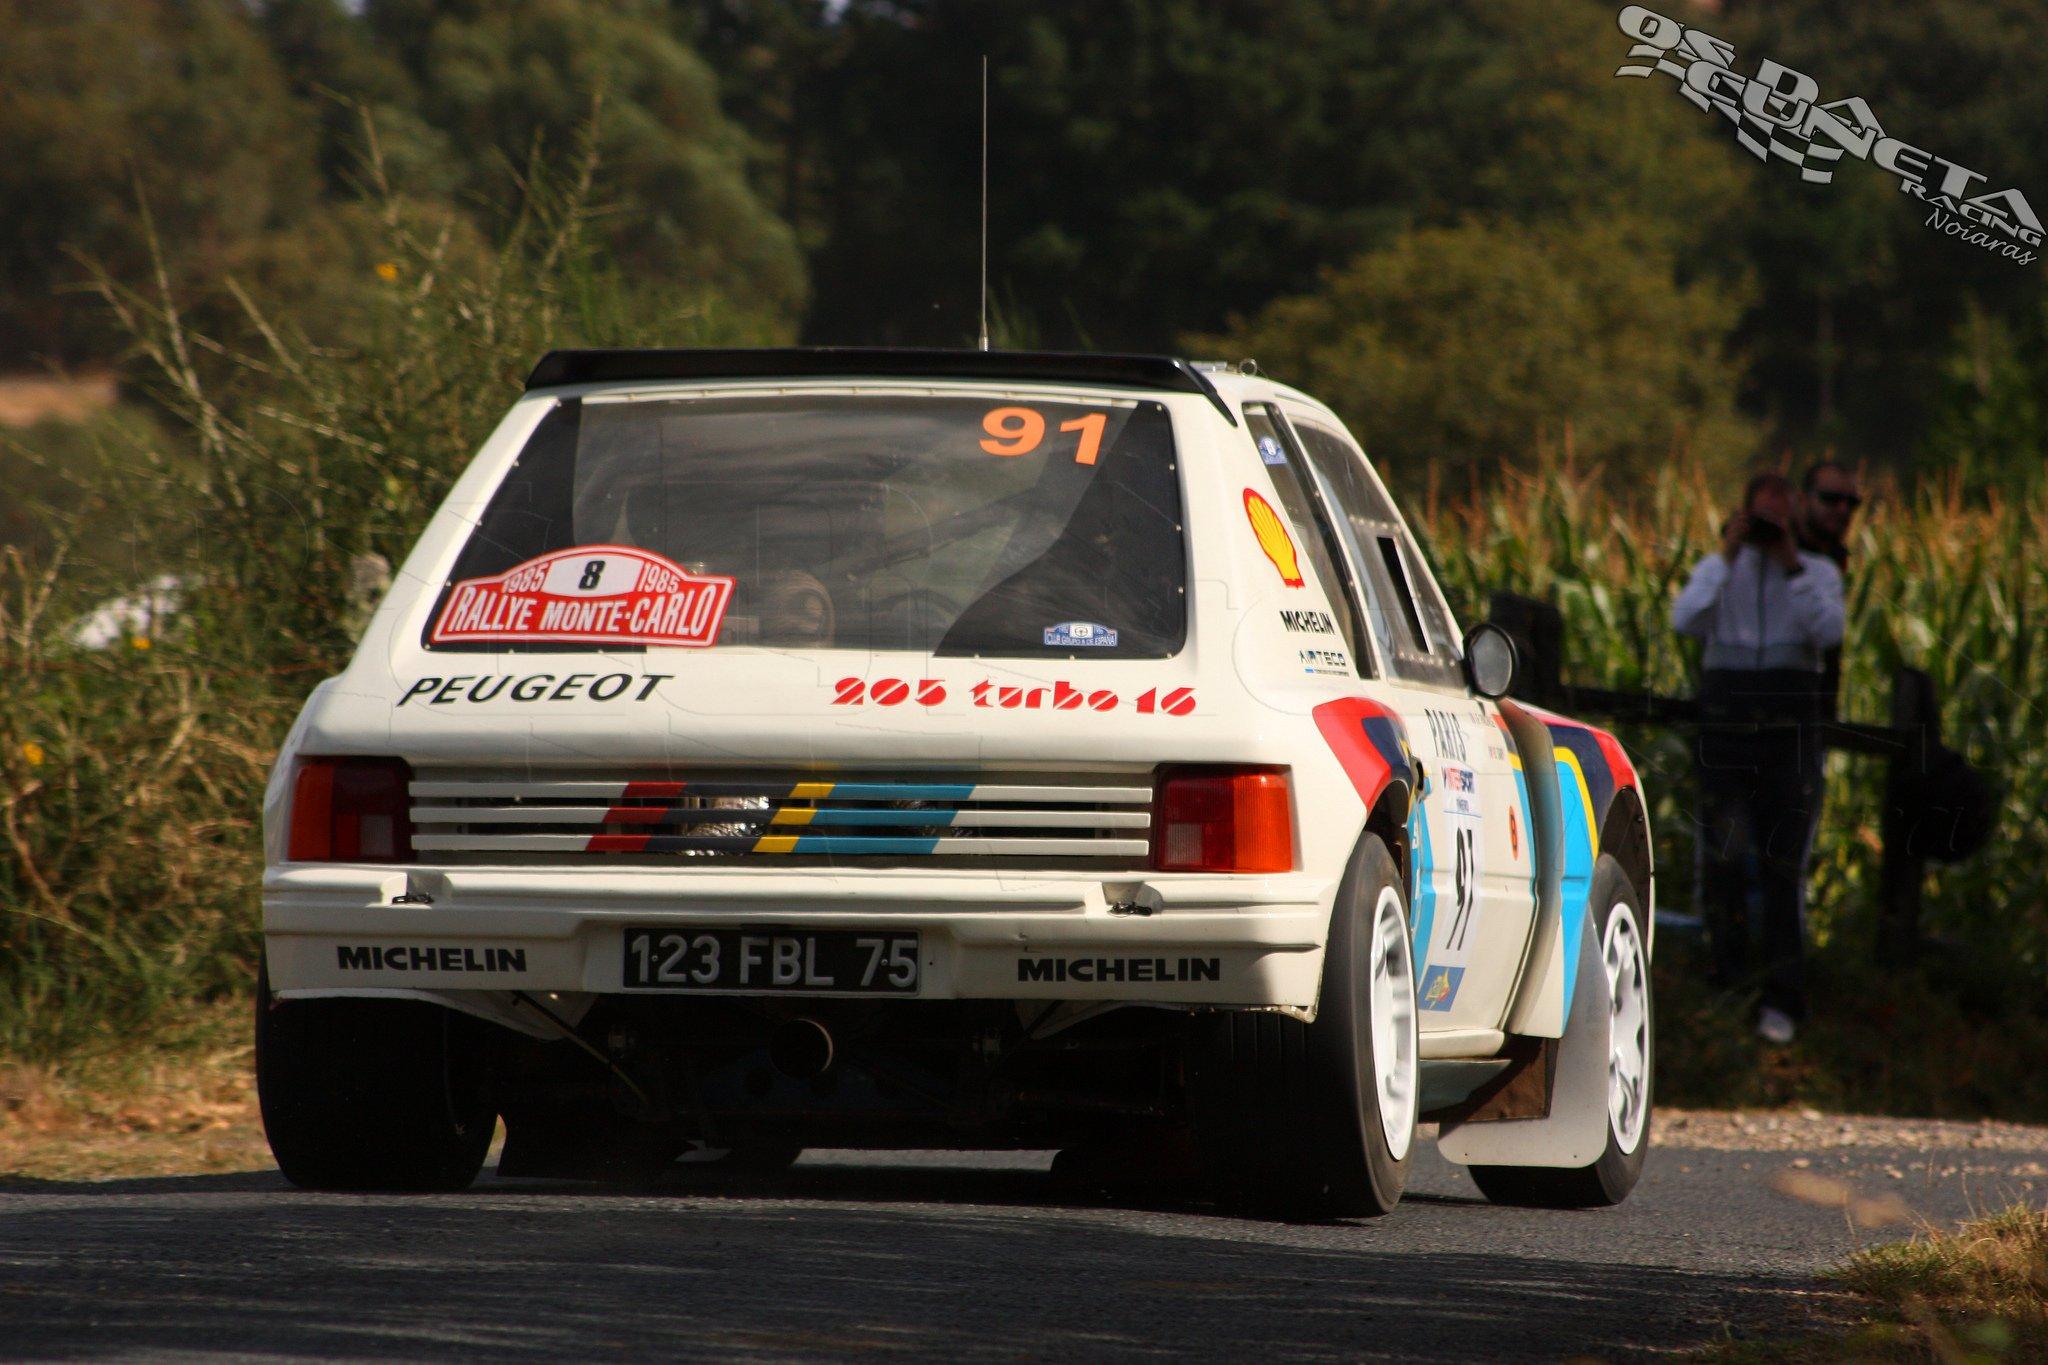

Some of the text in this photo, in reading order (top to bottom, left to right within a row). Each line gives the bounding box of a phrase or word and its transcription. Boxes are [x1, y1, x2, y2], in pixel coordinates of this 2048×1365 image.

[979, 407, 1107, 465] 91
[502, 563, 547, 592] 1985
[578, 560, 605, 590] 8
[638, 564, 680, 593] 1985
[447, 586, 537, 632] RALLYE
[1279, 610, 1335, 635] MICHELIN
[397, 673, 674, 707] PEUGEOT
[831, 677, 1197, 717] 205 turbo 16
[337, 947, 527, 972] MICHELIN
[630, 934, 917, 987] 123 FBL 75
[1017, 958, 1220, 982] MICHELIN
